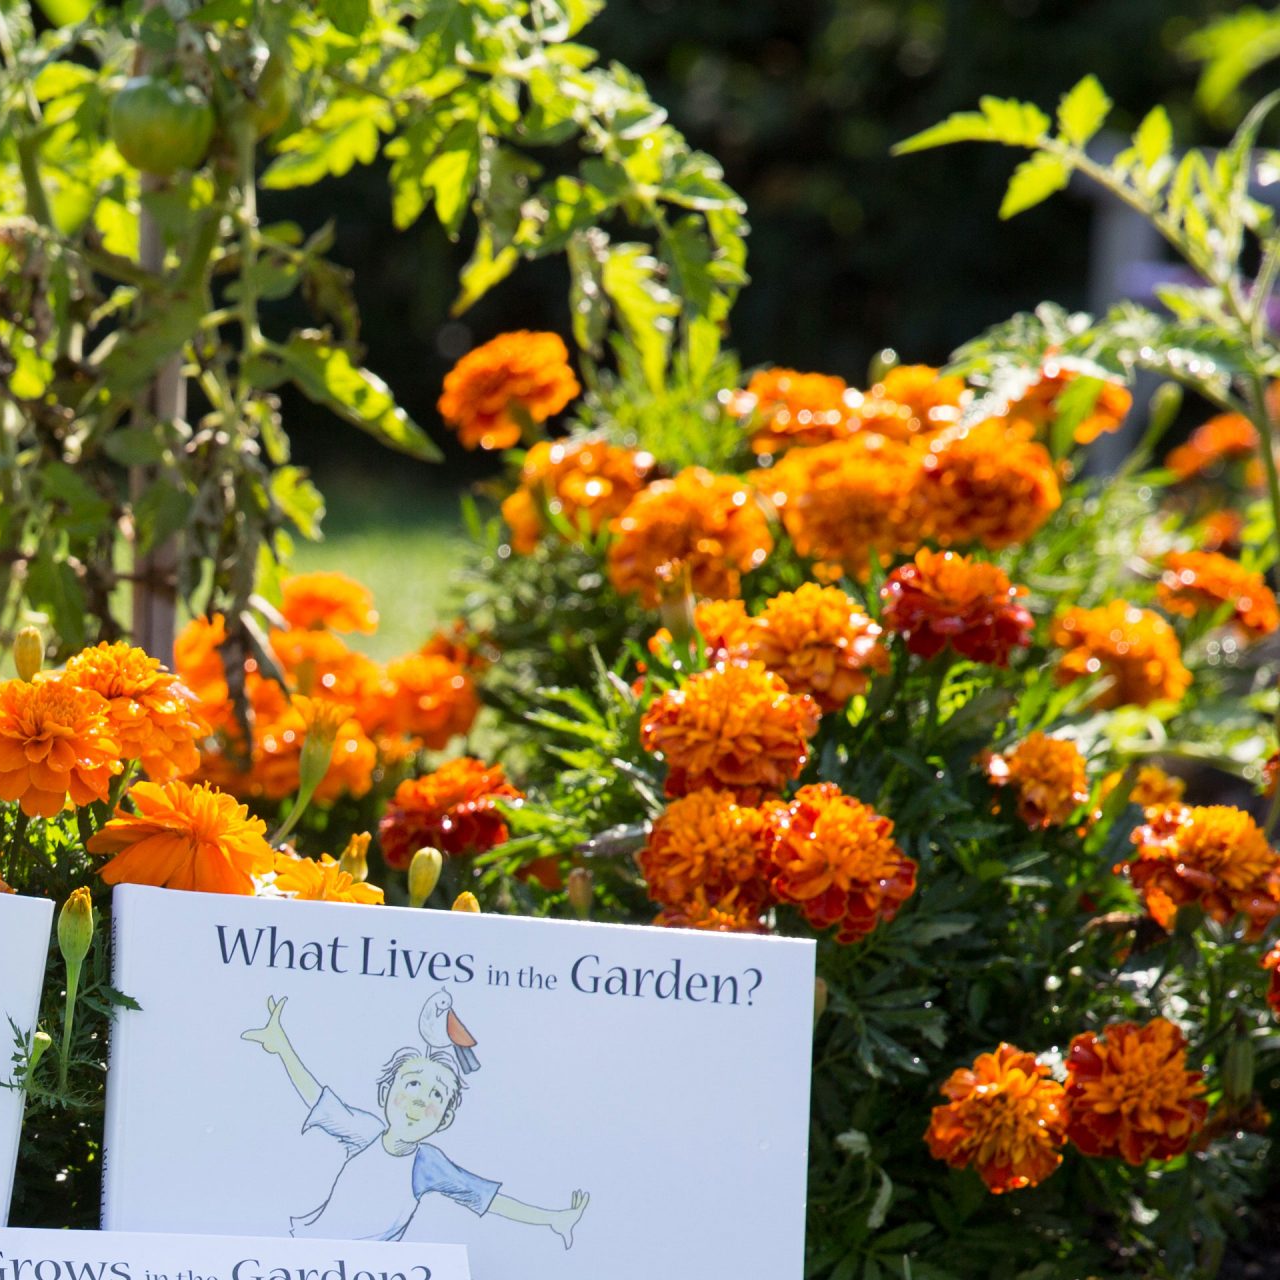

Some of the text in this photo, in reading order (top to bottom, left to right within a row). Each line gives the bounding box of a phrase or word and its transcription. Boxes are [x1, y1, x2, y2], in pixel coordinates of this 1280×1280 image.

[215, 924, 764, 1007] What Lives in the Garden?
